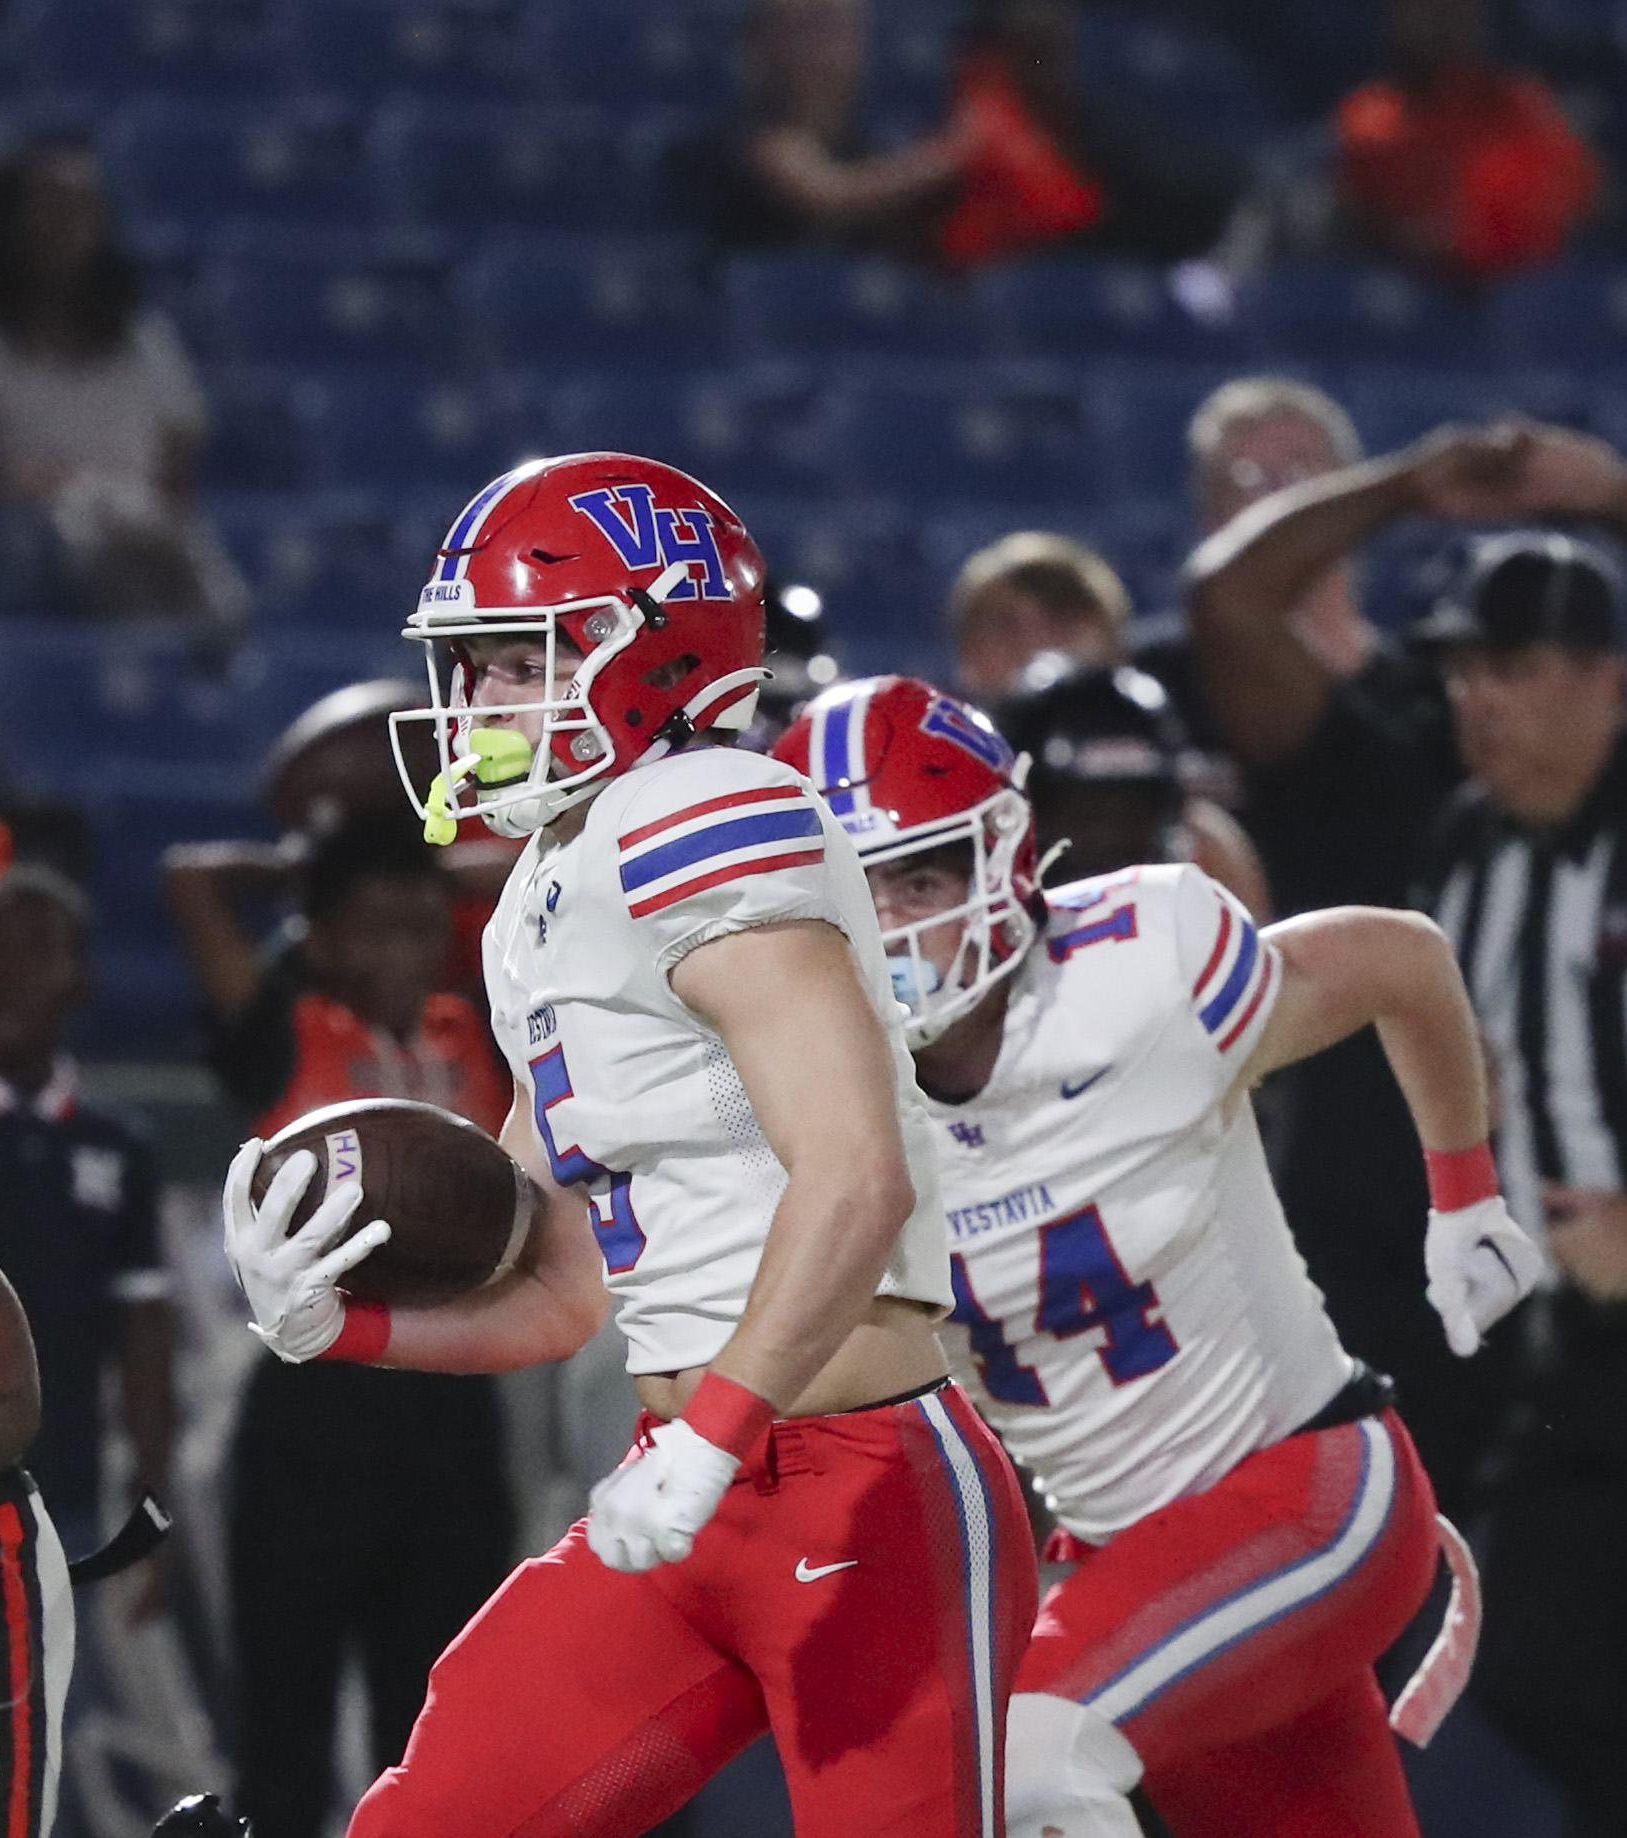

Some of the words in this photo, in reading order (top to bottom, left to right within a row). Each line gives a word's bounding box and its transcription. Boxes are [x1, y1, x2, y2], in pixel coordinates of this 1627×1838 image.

[569, 484, 734, 603] VH
[435, 585, 462, 601] HILLS
[333, 1135, 357, 1180] VH
[528, 1042, 647, 1276] 5
[946, 1184, 1056, 1237] VESTAVIA
[950, 1202, 1180, 1408] 14
